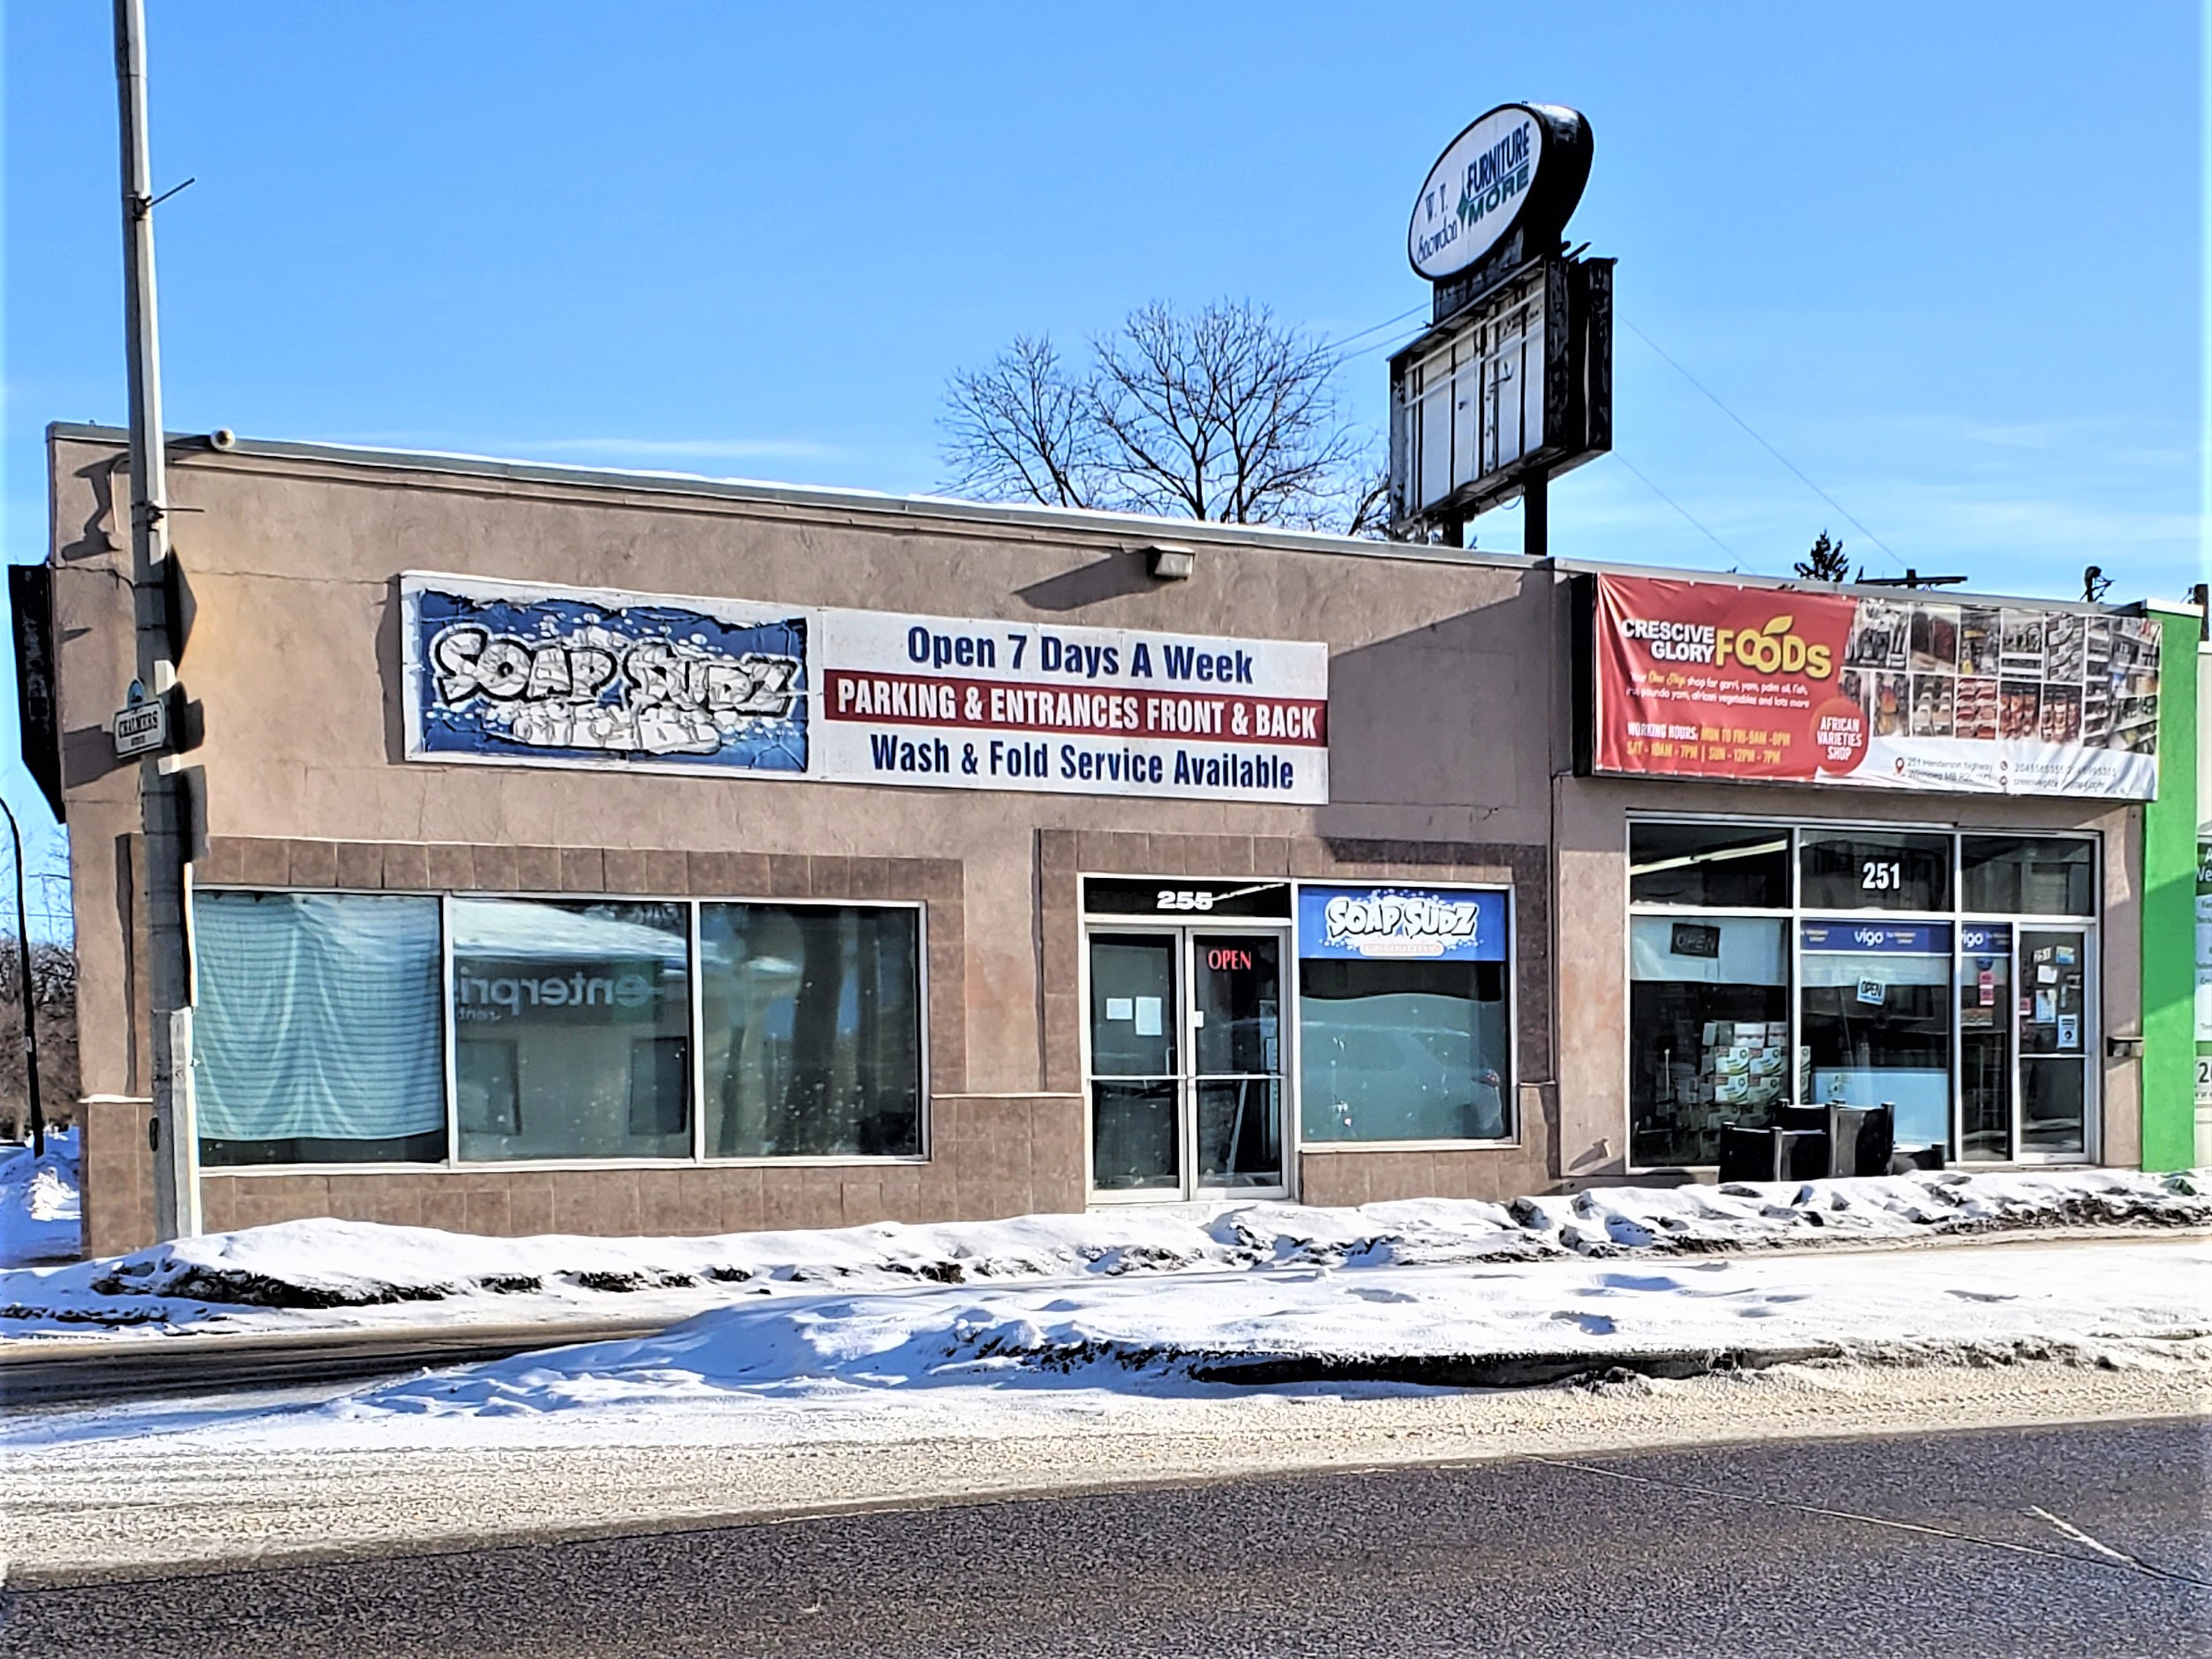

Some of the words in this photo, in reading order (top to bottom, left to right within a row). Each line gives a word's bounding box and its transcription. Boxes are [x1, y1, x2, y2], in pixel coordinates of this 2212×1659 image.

[1466, 121, 1530, 198] FURNITURE
[1468, 163, 1529, 228] MORE
[1622, 618, 1715, 644] CRESCIVE
[907, 625, 997, 671] Open
[1008, 634, 1028, 671] 7
[1040, 635, 1120, 680] Days
[1130, 642, 1153, 679] A
[1165, 645, 1255, 685] Week
[1651, 641, 1715, 663] GLORY
[434, 626, 619, 706] SOAP
[622, 641, 801, 717] SUDZ
[837, 678, 957, 722] PARKING
[964, 687, 983, 722] &
[990, 689, 1139, 732] ENTRANCES
[1147, 702, 1225, 735] FRONT
[1232, 703, 1249, 737] &
[1256, 705, 1317, 739] BACK
[1627, 721, 1668, 739] WORKING
[1668, 724, 1698, 740] HOURS:
[1700, 726, 1721, 741] MON
[1721, 728, 1731, 743] TO
[1819, 716, 1860, 733] AFRICAN
[1817, 731, 1863, 747] VARIETIES
[870, 733, 950, 774] Wash
[962, 741, 979, 775] &
[990, 739, 1049, 779] Fold
[1061, 744, 1164, 785] Service
[1173, 750, 1295, 790] Available
[1626, 740, 1643, 755] SAT
[1708, 746, 1726, 761] SUN
[1827, 746, 1852, 761] SHOP
[1863, 861, 1900, 890] 251
[1157, 890, 1213, 911] 255
[1328, 900, 1402, 939] SOAP
[1403, 900, 1478, 939] SUDZ
[1676, 933, 1716, 951] OPEN
[1855, 927, 1884, 947] vigo
[1208, 949, 1251, 970] OPEN
[1860, 979, 1882, 998] OPEN
